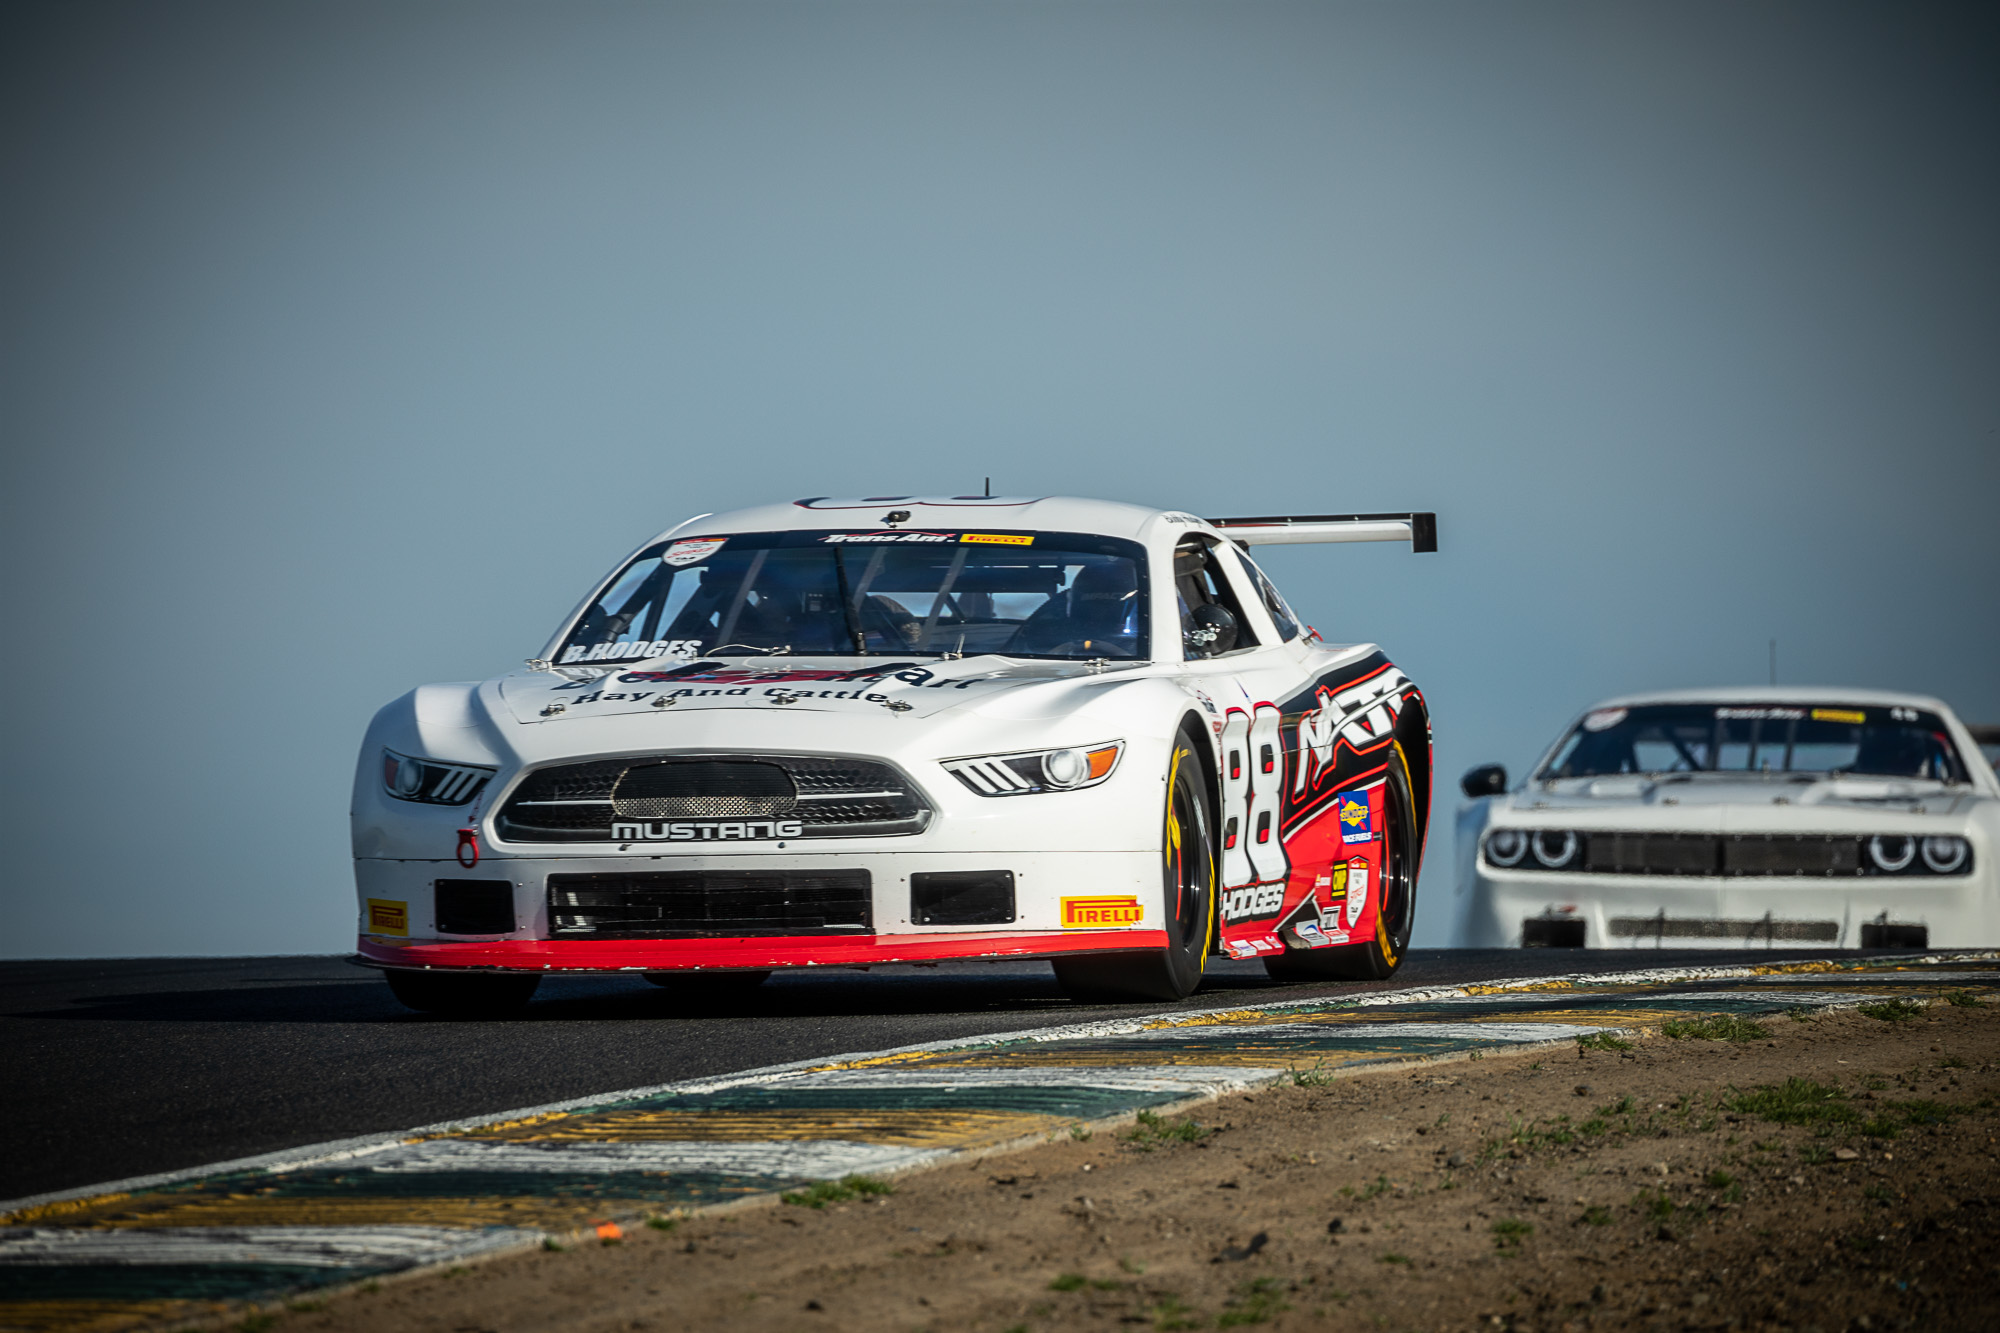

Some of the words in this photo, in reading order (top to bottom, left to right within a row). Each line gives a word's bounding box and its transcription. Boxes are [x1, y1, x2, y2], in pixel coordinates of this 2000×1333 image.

[571, 690, 655, 705] Hay
[669, 687, 752, 698] And
[763, 688, 890, 703] Cattle
[1222, 702, 1289, 888] 88
[611, 820, 803, 840] MUSTANG
[1066, 899, 1140, 923] PIRELLI
[1220, 882, 1285, 921] HODGES
[371, 905, 405, 930] PIRELLI
